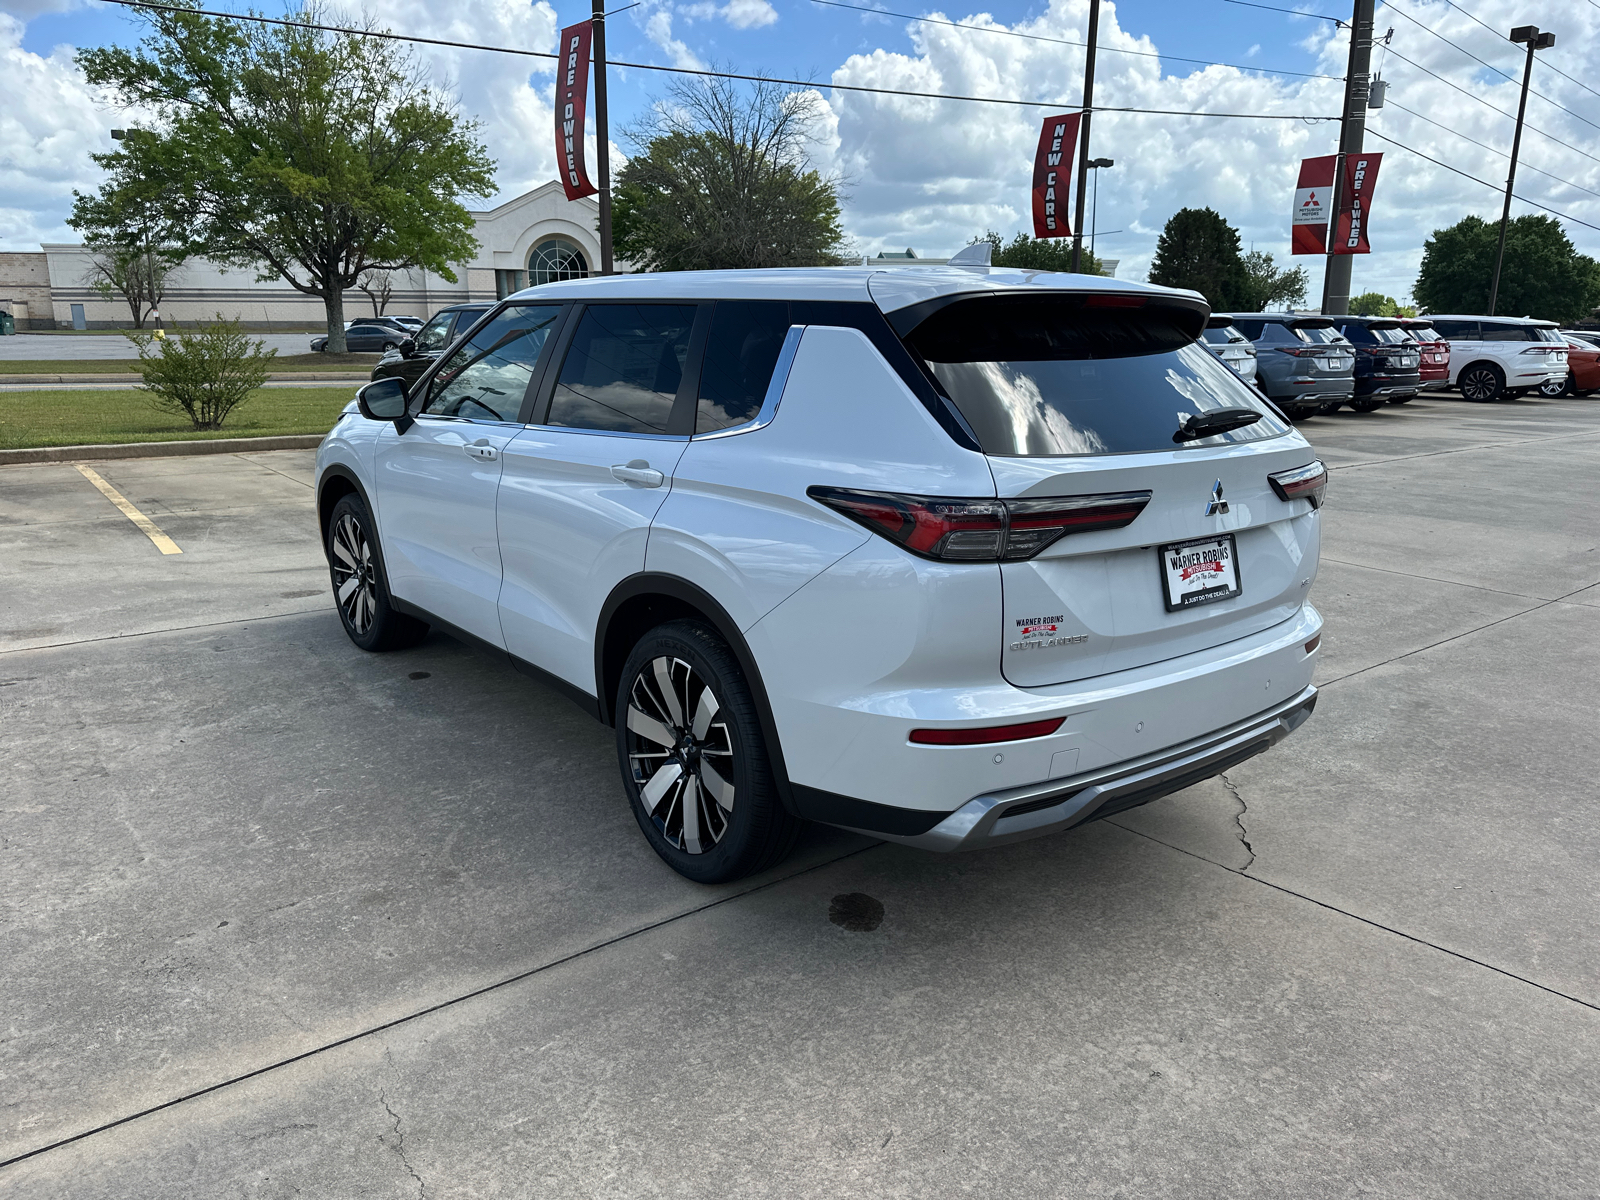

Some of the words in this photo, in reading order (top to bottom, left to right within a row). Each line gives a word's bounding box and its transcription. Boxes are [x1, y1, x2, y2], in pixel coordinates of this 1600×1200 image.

[1047, 123, 1066, 167] NEW
[1045, 172, 1057, 230] CARS
[1170, 552, 1201, 571] WARNER
[1202, 547, 1229, 563] ROBINS
[1187, 562, 1217, 575] MITSUBISHI
[1189, 595, 1199, 604] JUST
[1205, 592, 1213, 600] THE
[1016, 617, 1042, 627] WARNER
[1043, 615, 1064, 624] ROBINS
[655, 640, 695, 660] NEXEN
[1010, 634, 1089, 651] OUTLANDER
